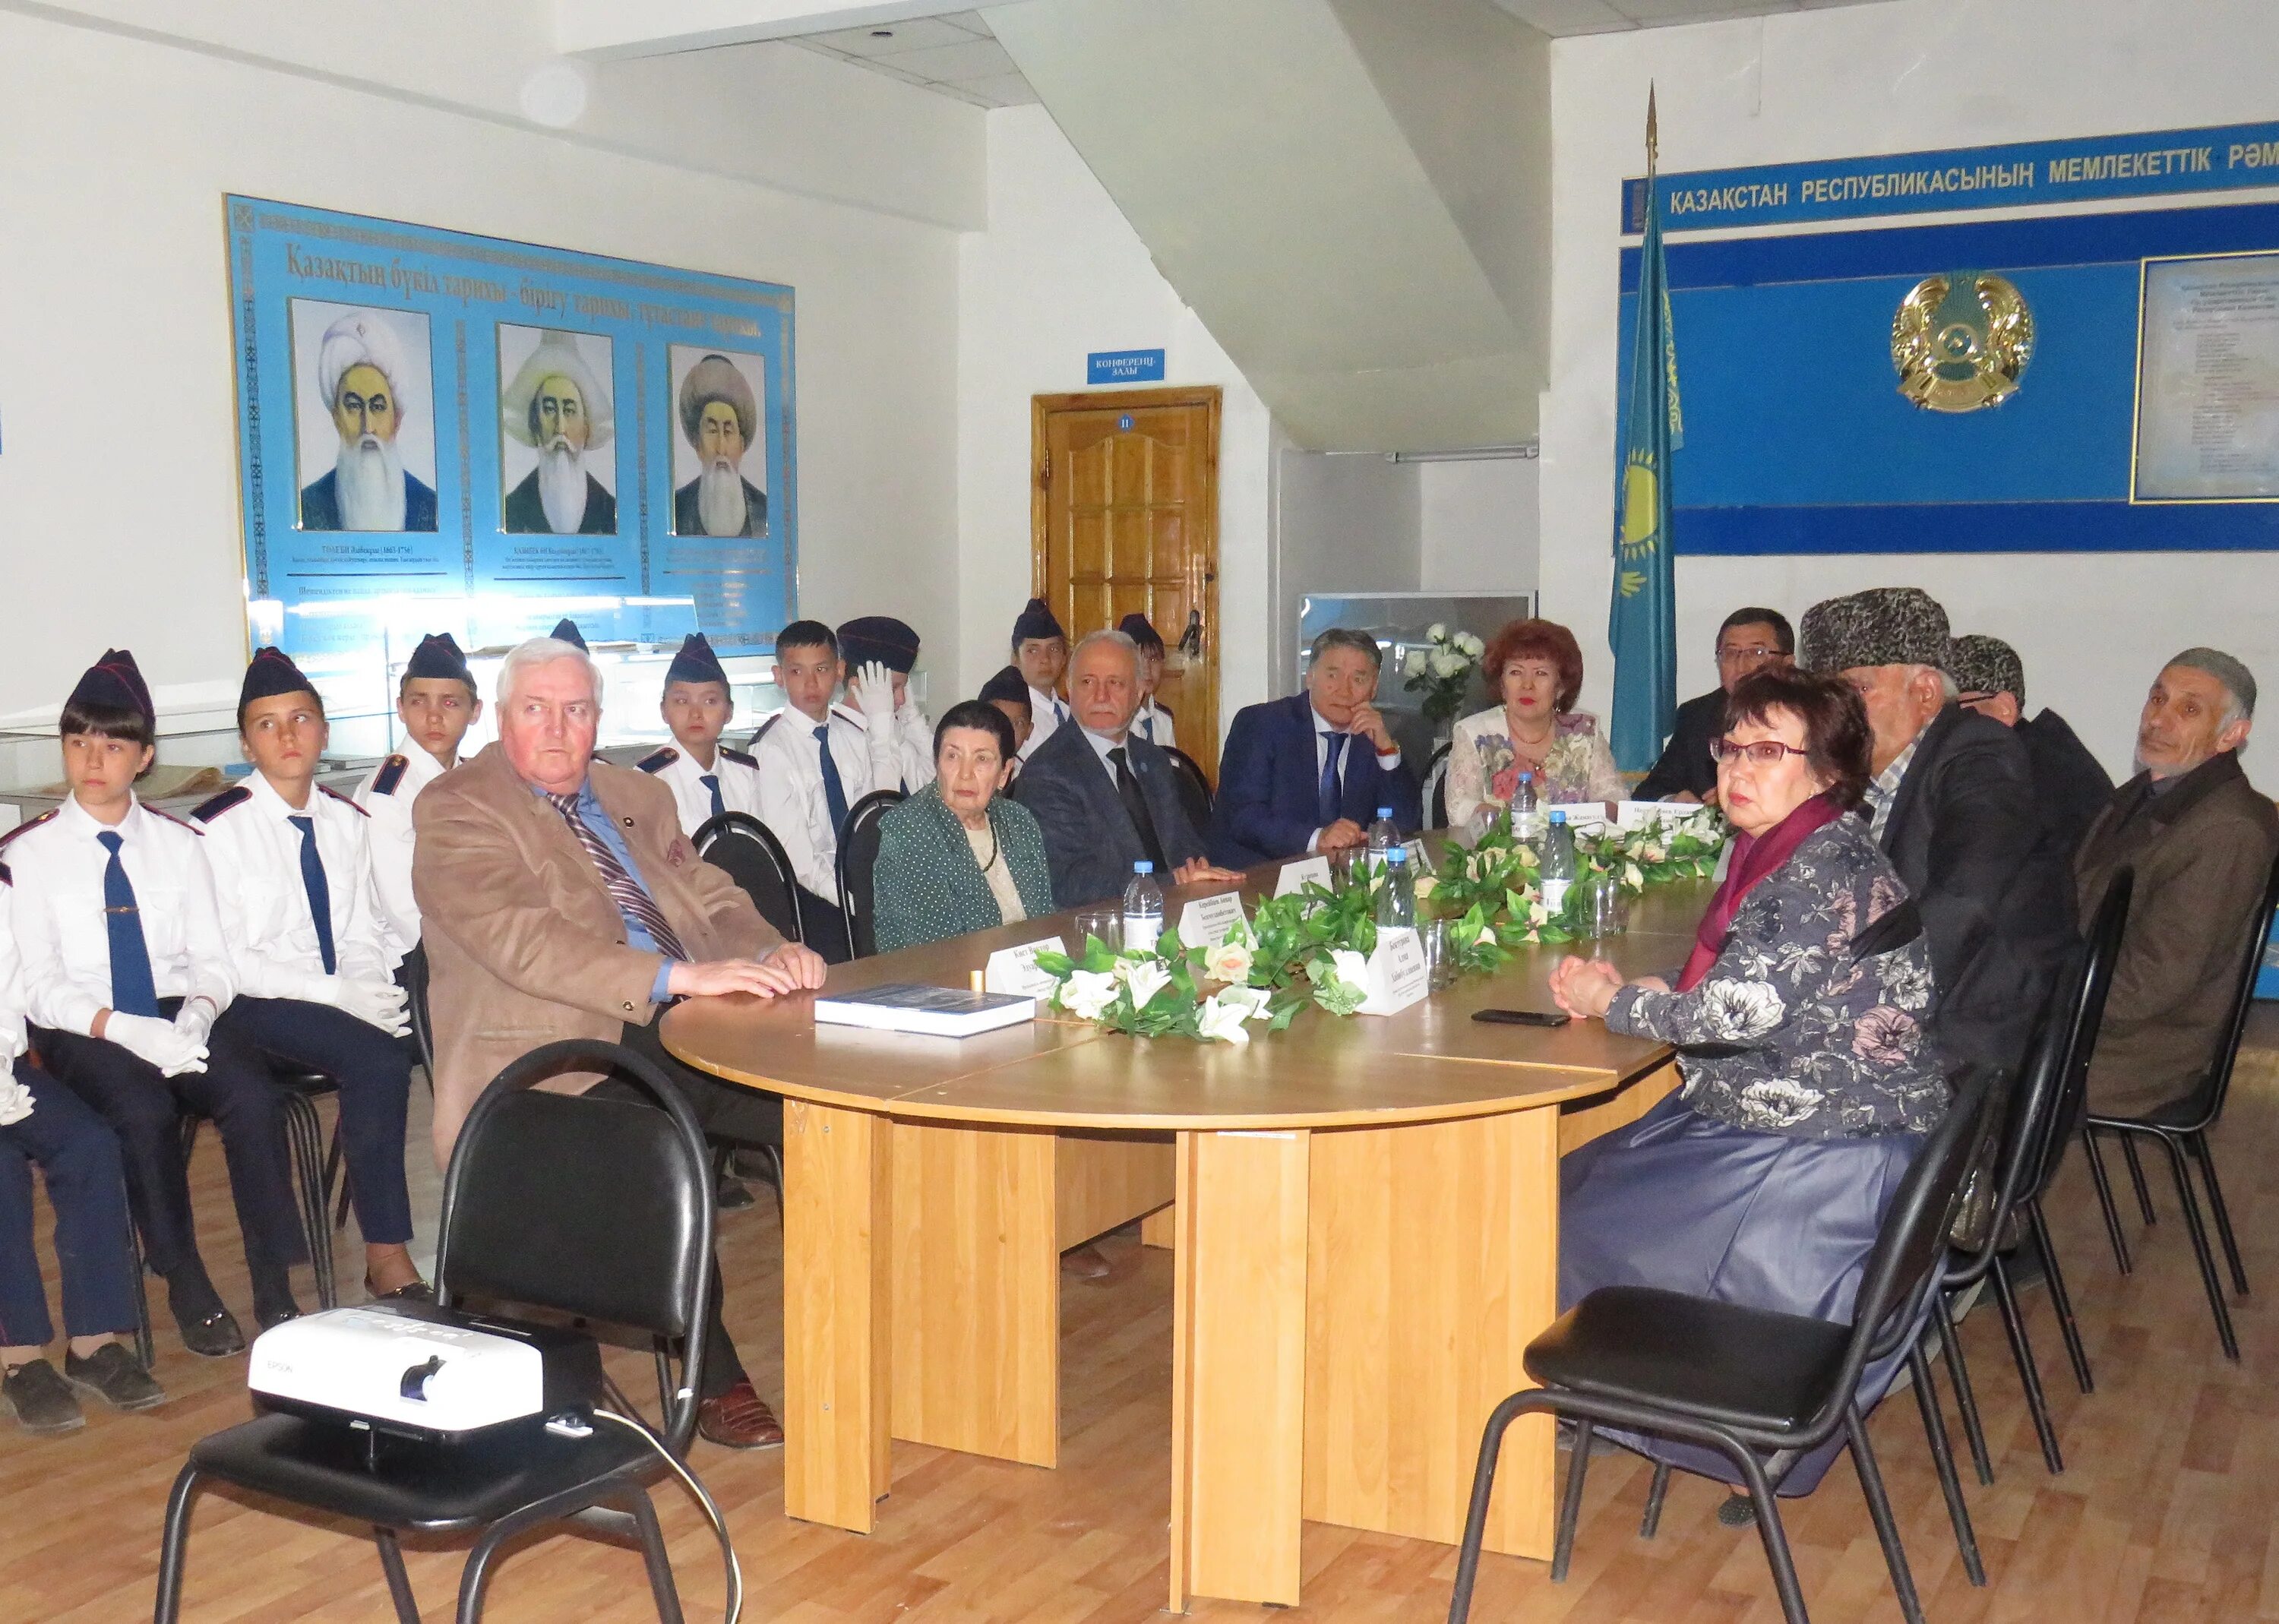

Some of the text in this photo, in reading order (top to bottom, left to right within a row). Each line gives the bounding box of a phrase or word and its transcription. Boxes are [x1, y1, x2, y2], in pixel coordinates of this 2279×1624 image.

[1671, 183, 1787, 216] ҚАЗАҚСТАН
[1802, 162, 2034, 203] РЕСПУБЛИКАСЫНЫҢ
[2050, 147, 2212, 183] МЕМЛЕКЕТТІК
[286, 242, 386, 292] Қазақтың
[1112, 367, 1137, 376] ЗАЛЫ
